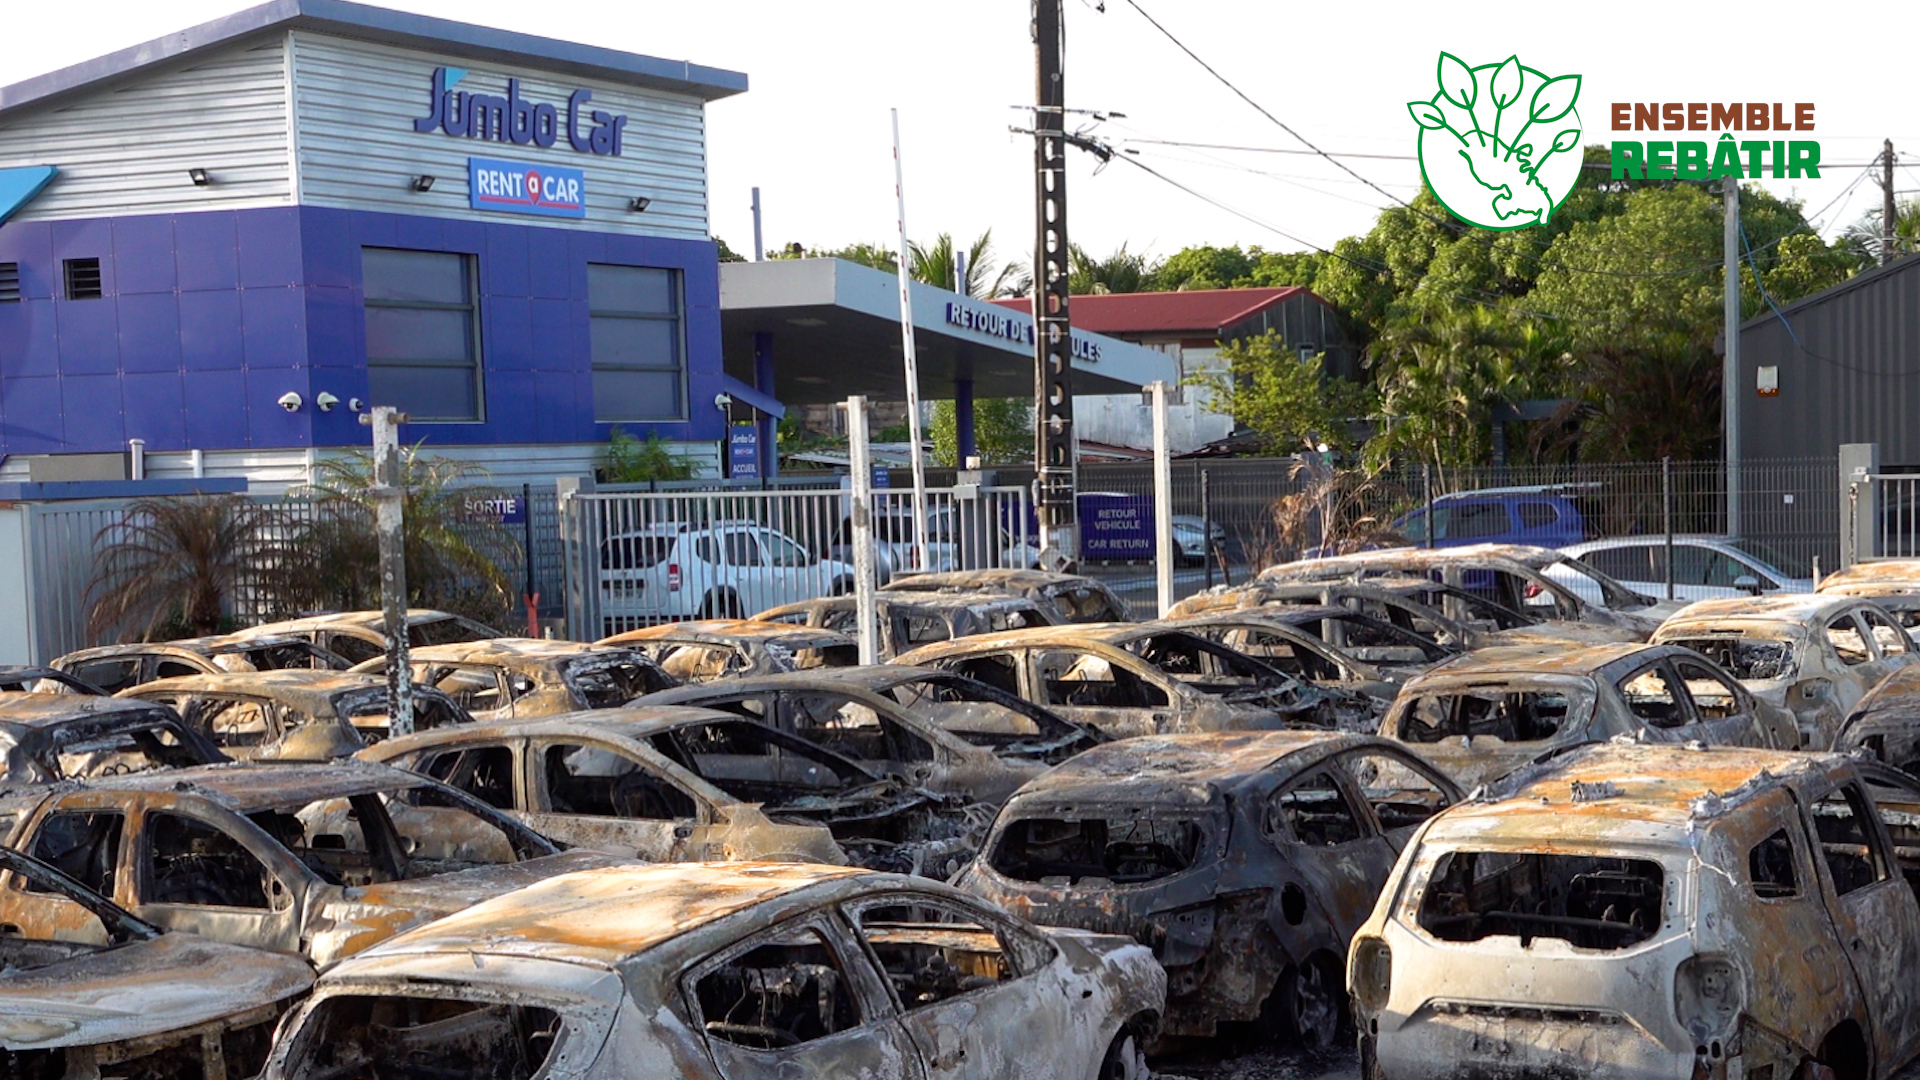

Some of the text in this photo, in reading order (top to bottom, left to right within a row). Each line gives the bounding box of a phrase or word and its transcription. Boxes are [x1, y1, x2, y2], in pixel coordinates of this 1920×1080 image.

[414, 67, 627, 156] Jumbo Car
[477, 169, 523, 197] RENT
[543, 176, 580, 204] CAR
[947, 302, 1030, 343] RETOUR DE
[732, 464, 757, 473] ACCUEIL
[464, 500, 516, 514] SORTIE
[1098, 509, 1136, 518] RETOUR
[1094, 520, 1140, 529] VEHICULE
[1088, 539, 1149, 549] CAR RETURN
